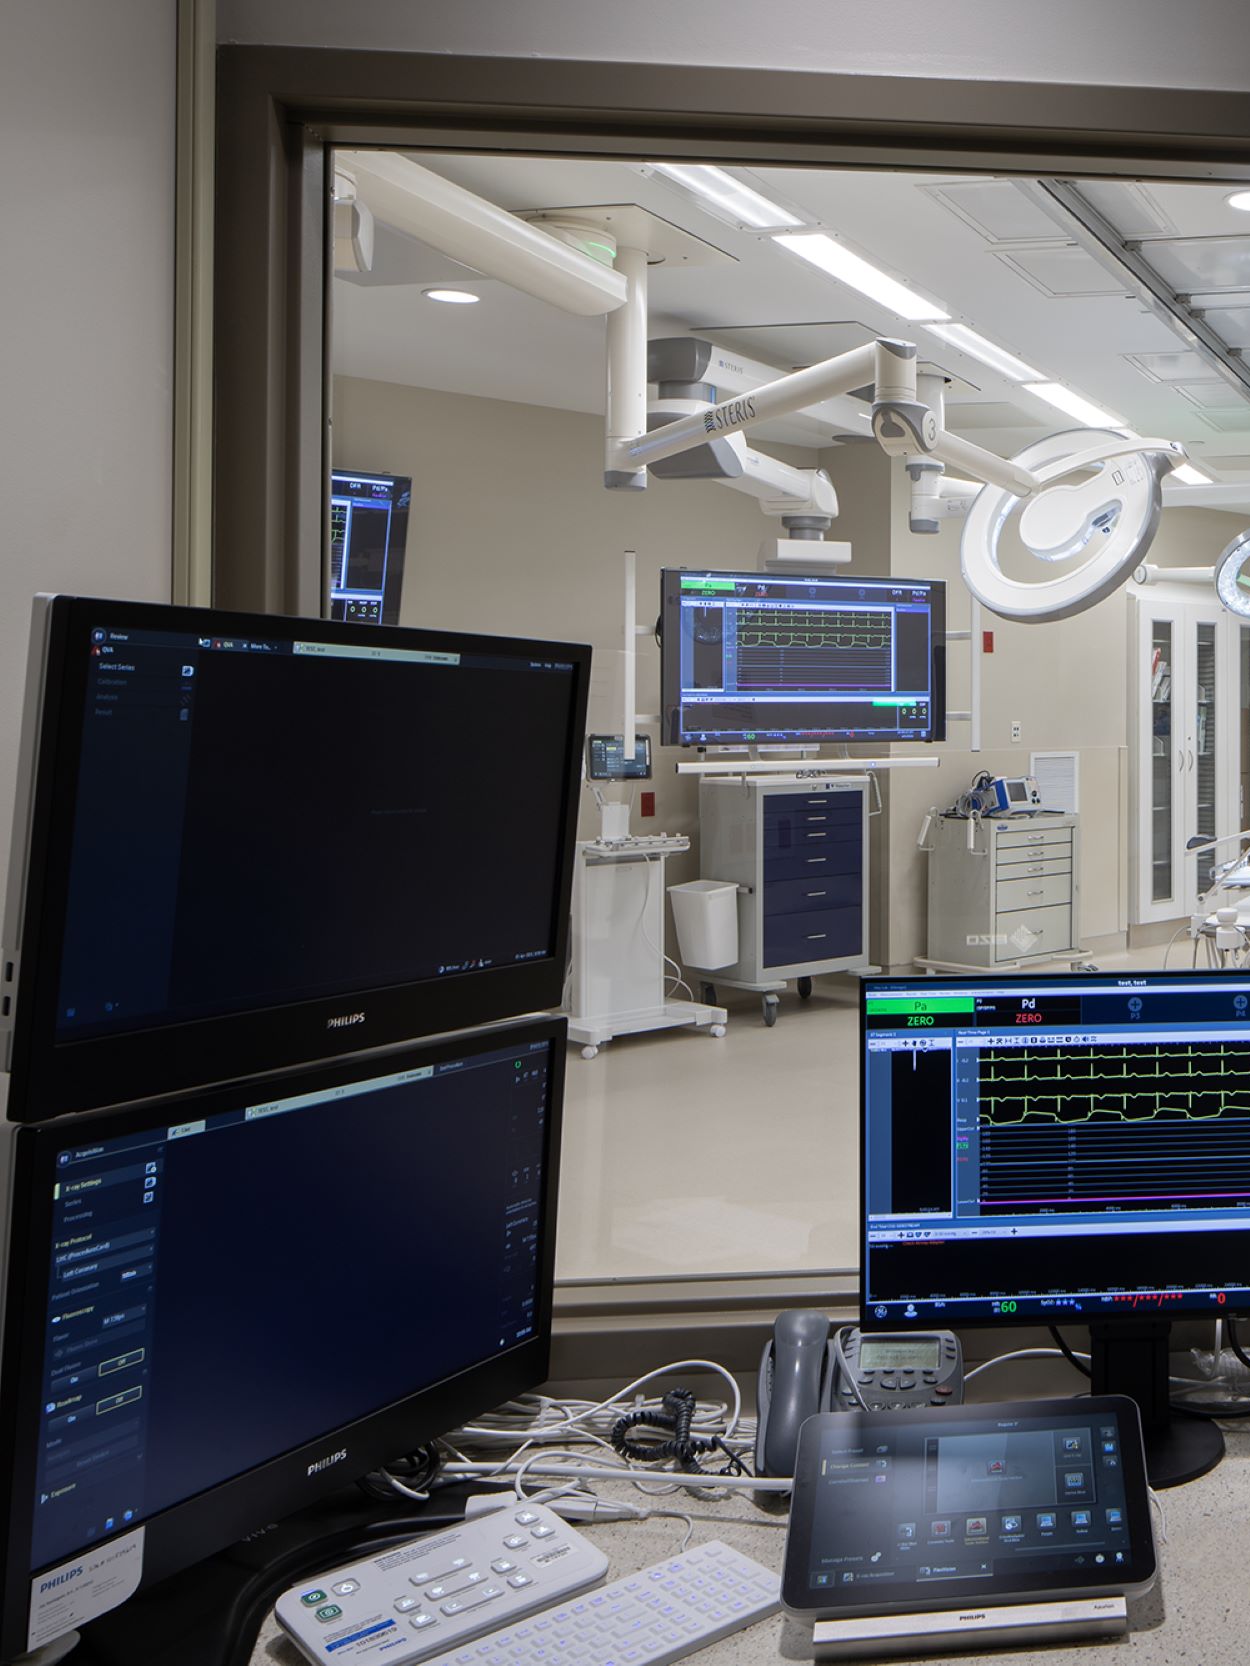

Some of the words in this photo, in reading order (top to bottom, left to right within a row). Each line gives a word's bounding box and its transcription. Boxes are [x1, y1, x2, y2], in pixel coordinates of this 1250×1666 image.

[725, 362, 744, 374] STERIS
[715, 397, 755, 429] STERIS
[928, 418, 936, 441] 3
[99, 662, 118, 671] Select
[118, 663, 136, 672] Series
[914, 1001, 927, 1012] Pa
[1022, 998, 1036, 1009] Pd
[326, 1012, 365, 1029] PHILIPS
[907, 1016, 934, 1027] ZERO
[1015, 1014, 1042, 1024] ZERO
[76, 1147, 104, 1158] Acquisition
[66, 1184, 81, 1192] X-ray
[81, 1178, 102, 1189] Settings
[65, 1199, 82, 1208] Series
[64, 1211, 93, 1223] Processing
[55, 1241, 70, 1249] X-ray
[70, 1233, 92, 1244] Protocol
[63, 1270, 74, 1278] Left
[74, 1264, 98, 1275] Coronary
[1217, 1293, 1226, 1304] 0
[1001, 1301, 1017, 1313] 60
[62, 1306, 95, 1321] Fluoroscopy
[70, 1376, 79, 1384] On
[306, 1448, 348, 1476] PHILIPS
[40, 1565, 84, 1594] PHILIPS
